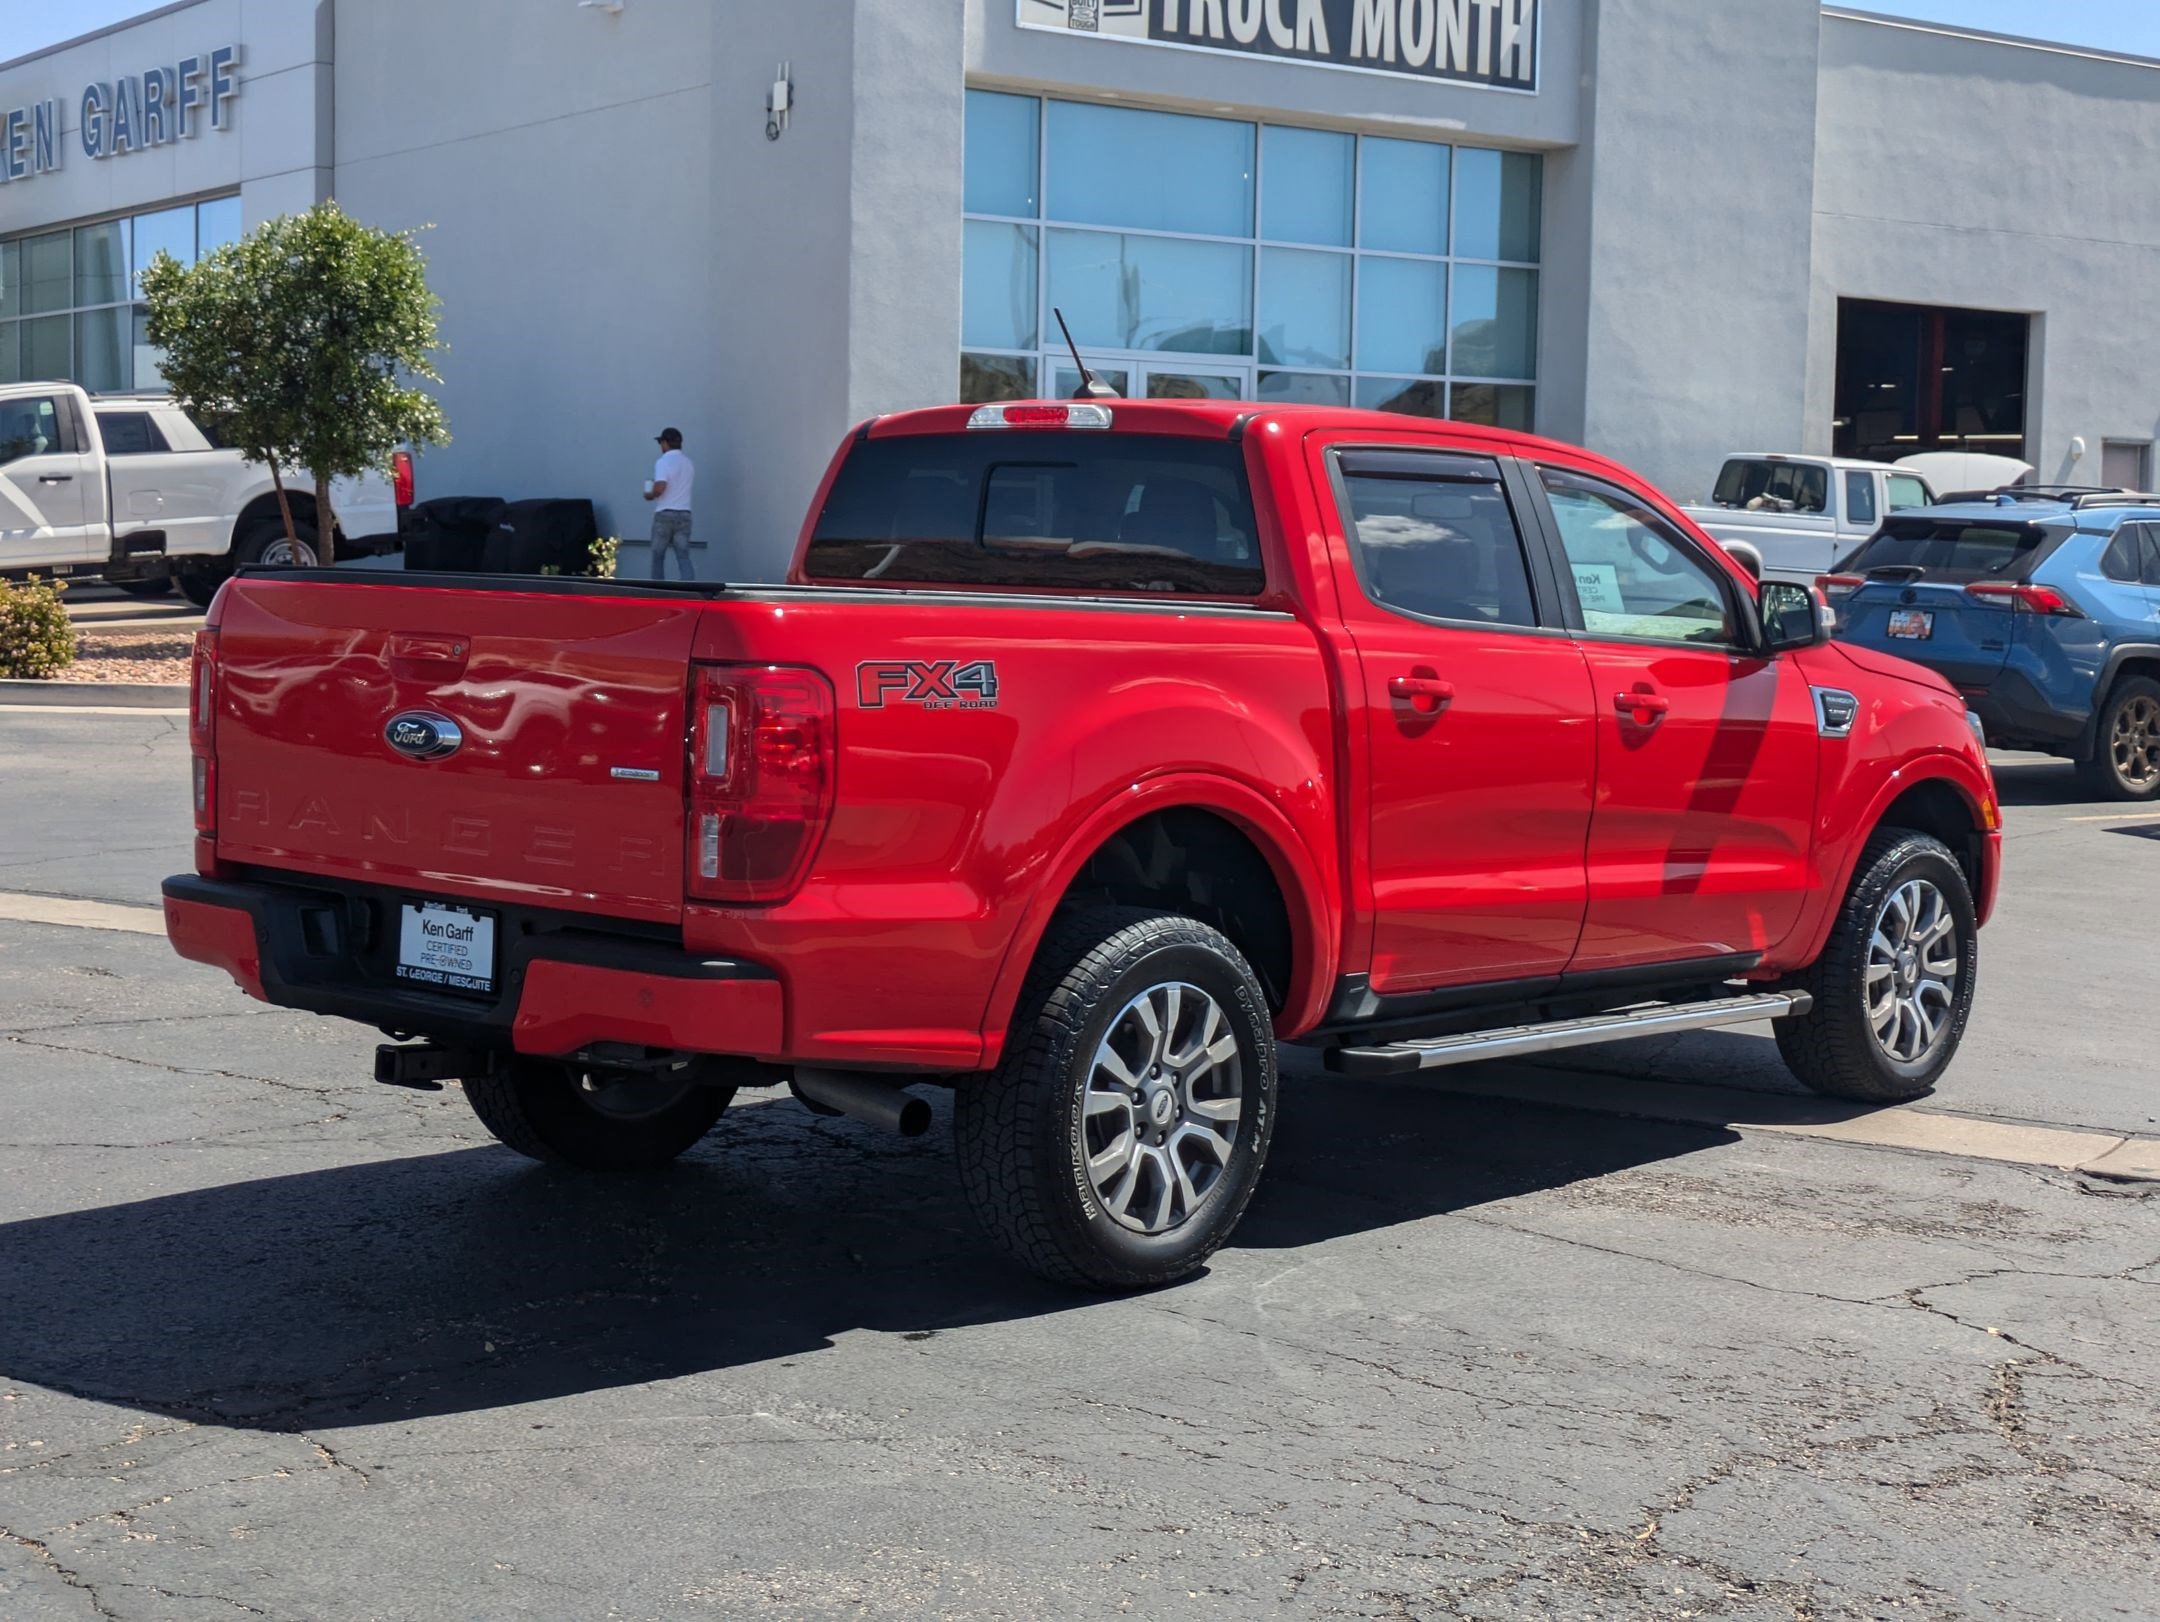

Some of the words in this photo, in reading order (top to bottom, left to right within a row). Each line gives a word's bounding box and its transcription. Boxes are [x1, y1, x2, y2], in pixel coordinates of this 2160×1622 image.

[1350, 0, 1532, 81] MONTH
[0, 97, 62, 184] EN
[80, 44, 241, 160] GARFF
[855, 659, 999, 709] FX4
[959, 701, 998, 710] ROAD
[394, 721, 426, 745] Ford
[228, 788, 665, 876] RANGER
[422, 919, 444, 936] Ken
[446, 923, 474, 942] Garff
[426, 940, 468, 957] CERTIFIED
[420, 952, 472, 971] PRE-OWNED
[409, 968, 443, 984] GEORGE
